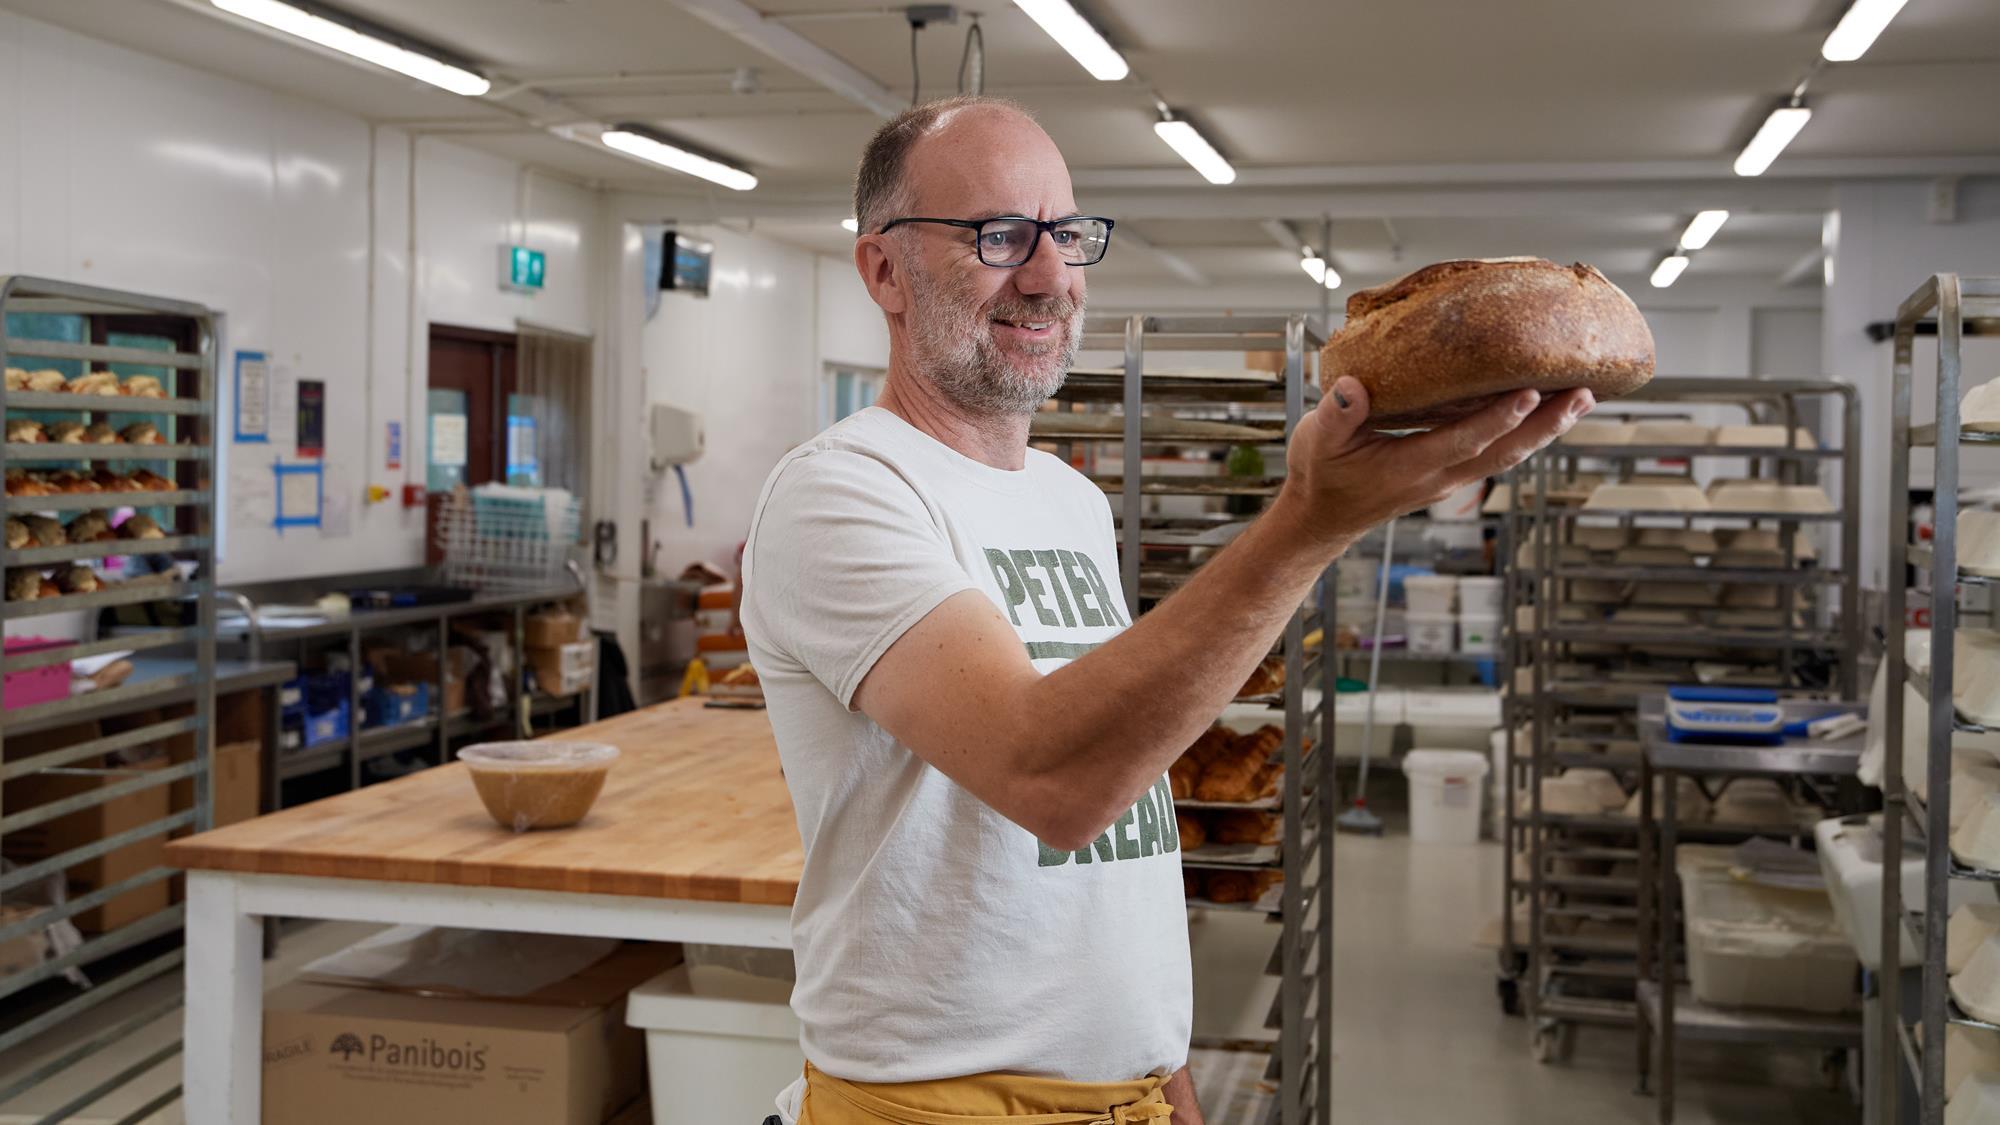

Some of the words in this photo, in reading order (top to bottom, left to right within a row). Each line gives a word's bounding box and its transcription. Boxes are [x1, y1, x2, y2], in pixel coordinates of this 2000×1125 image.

[983, 547, 1127, 628] PETER
[1037, 775, 1178, 867] EAD
[263, 1039, 312, 1063] RAGILE
[370, 1034, 487, 1072] Panibois
